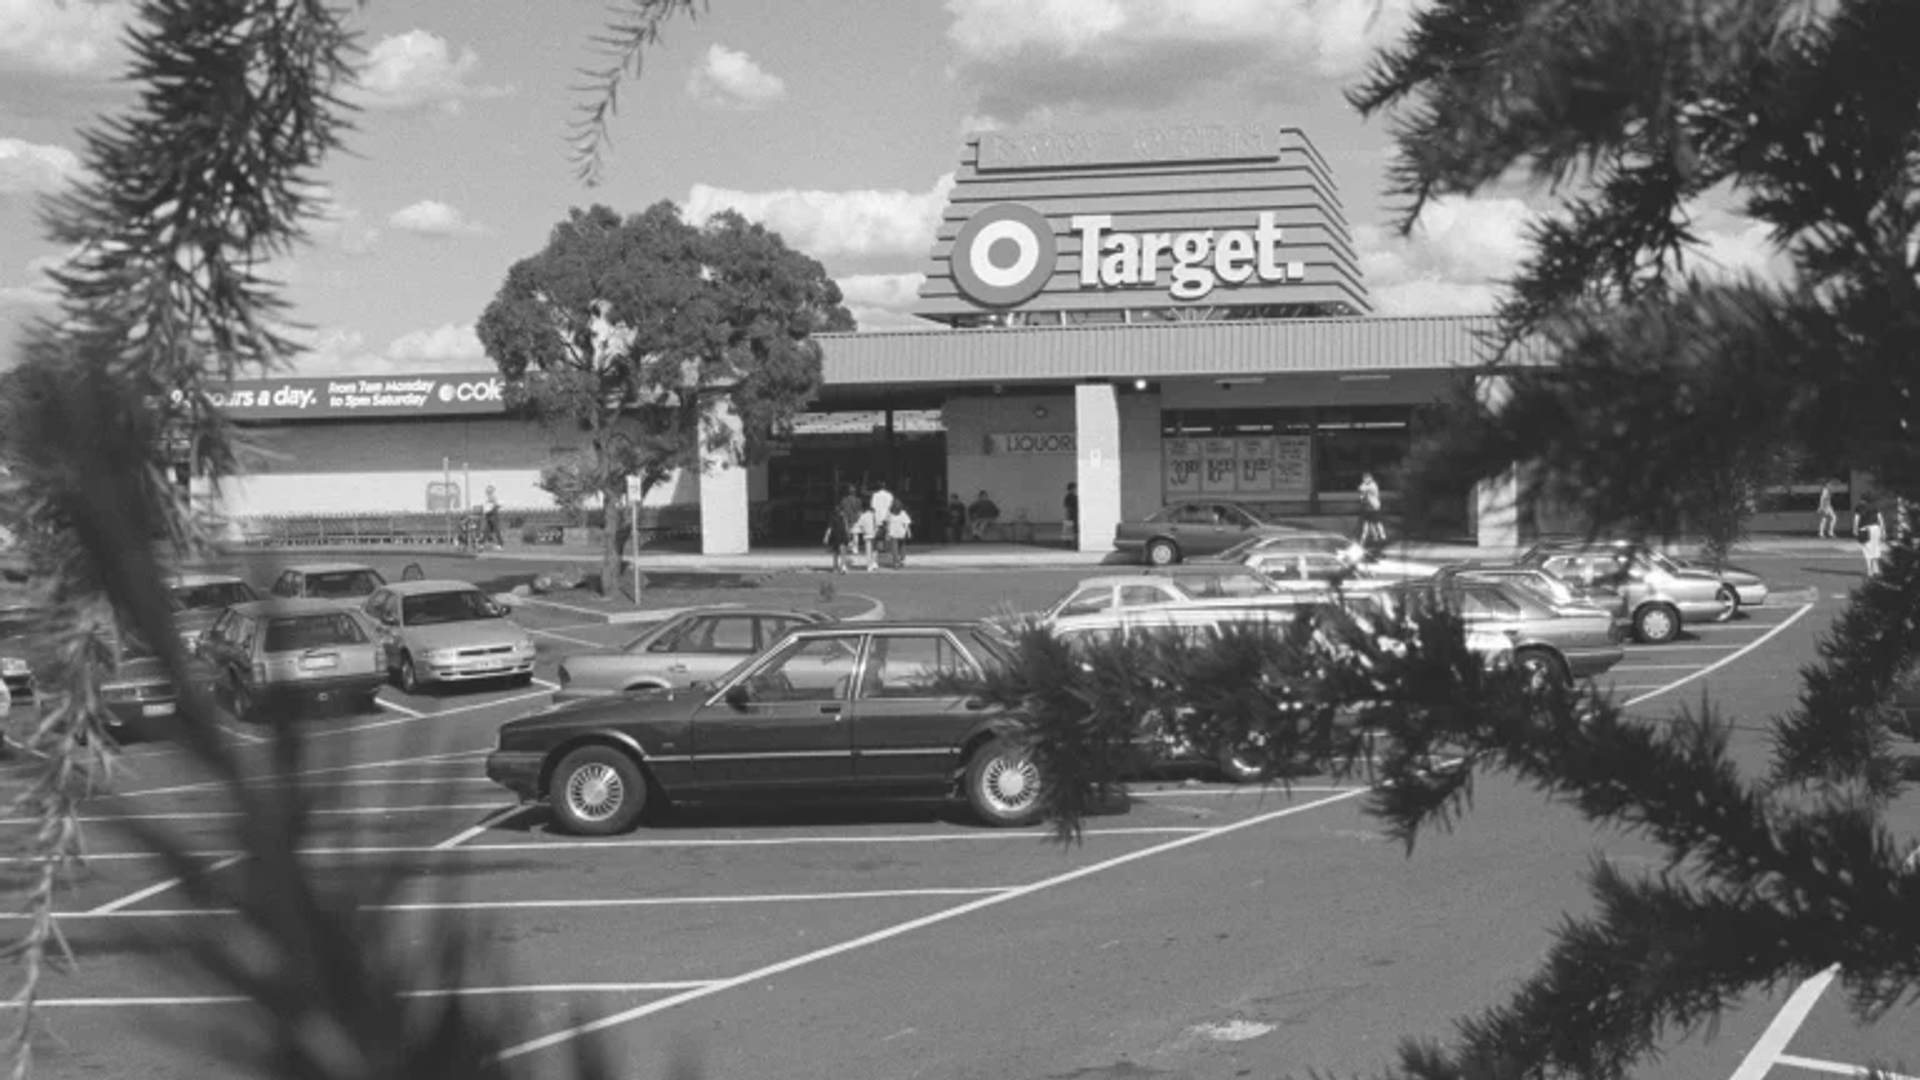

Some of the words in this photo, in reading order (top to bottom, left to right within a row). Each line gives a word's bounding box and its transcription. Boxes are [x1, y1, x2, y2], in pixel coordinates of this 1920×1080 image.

[1071, 211, 1304, 299] Target.
[328, 381, 357, 394] From
[385, 378, 436, 394] Monday
[257, 390, 271, 406] a
[273, 385, 317, 409] day.
[330, 395, 344, 406] to
[372, 392, 428, 408] Saturday
